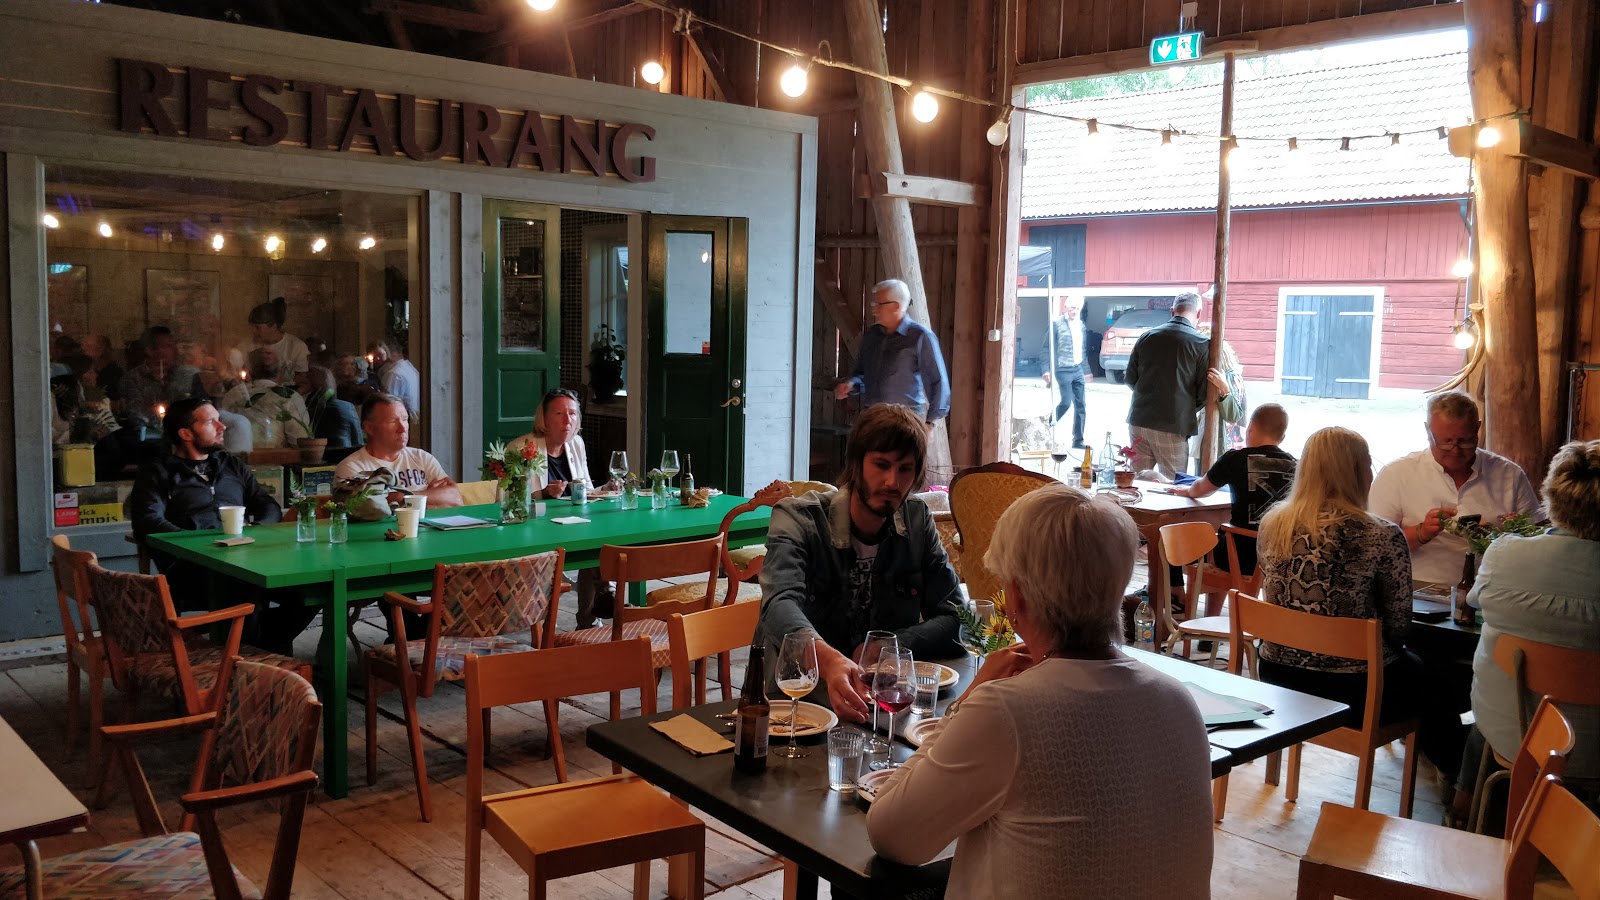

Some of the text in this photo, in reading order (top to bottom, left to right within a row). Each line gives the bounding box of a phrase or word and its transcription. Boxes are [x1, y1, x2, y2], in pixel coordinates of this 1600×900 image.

[117, 57, 657, 184] RESTAURANG
[398, 468, 429, 488] SPOR
[80, 513, 118, 525] mpis
